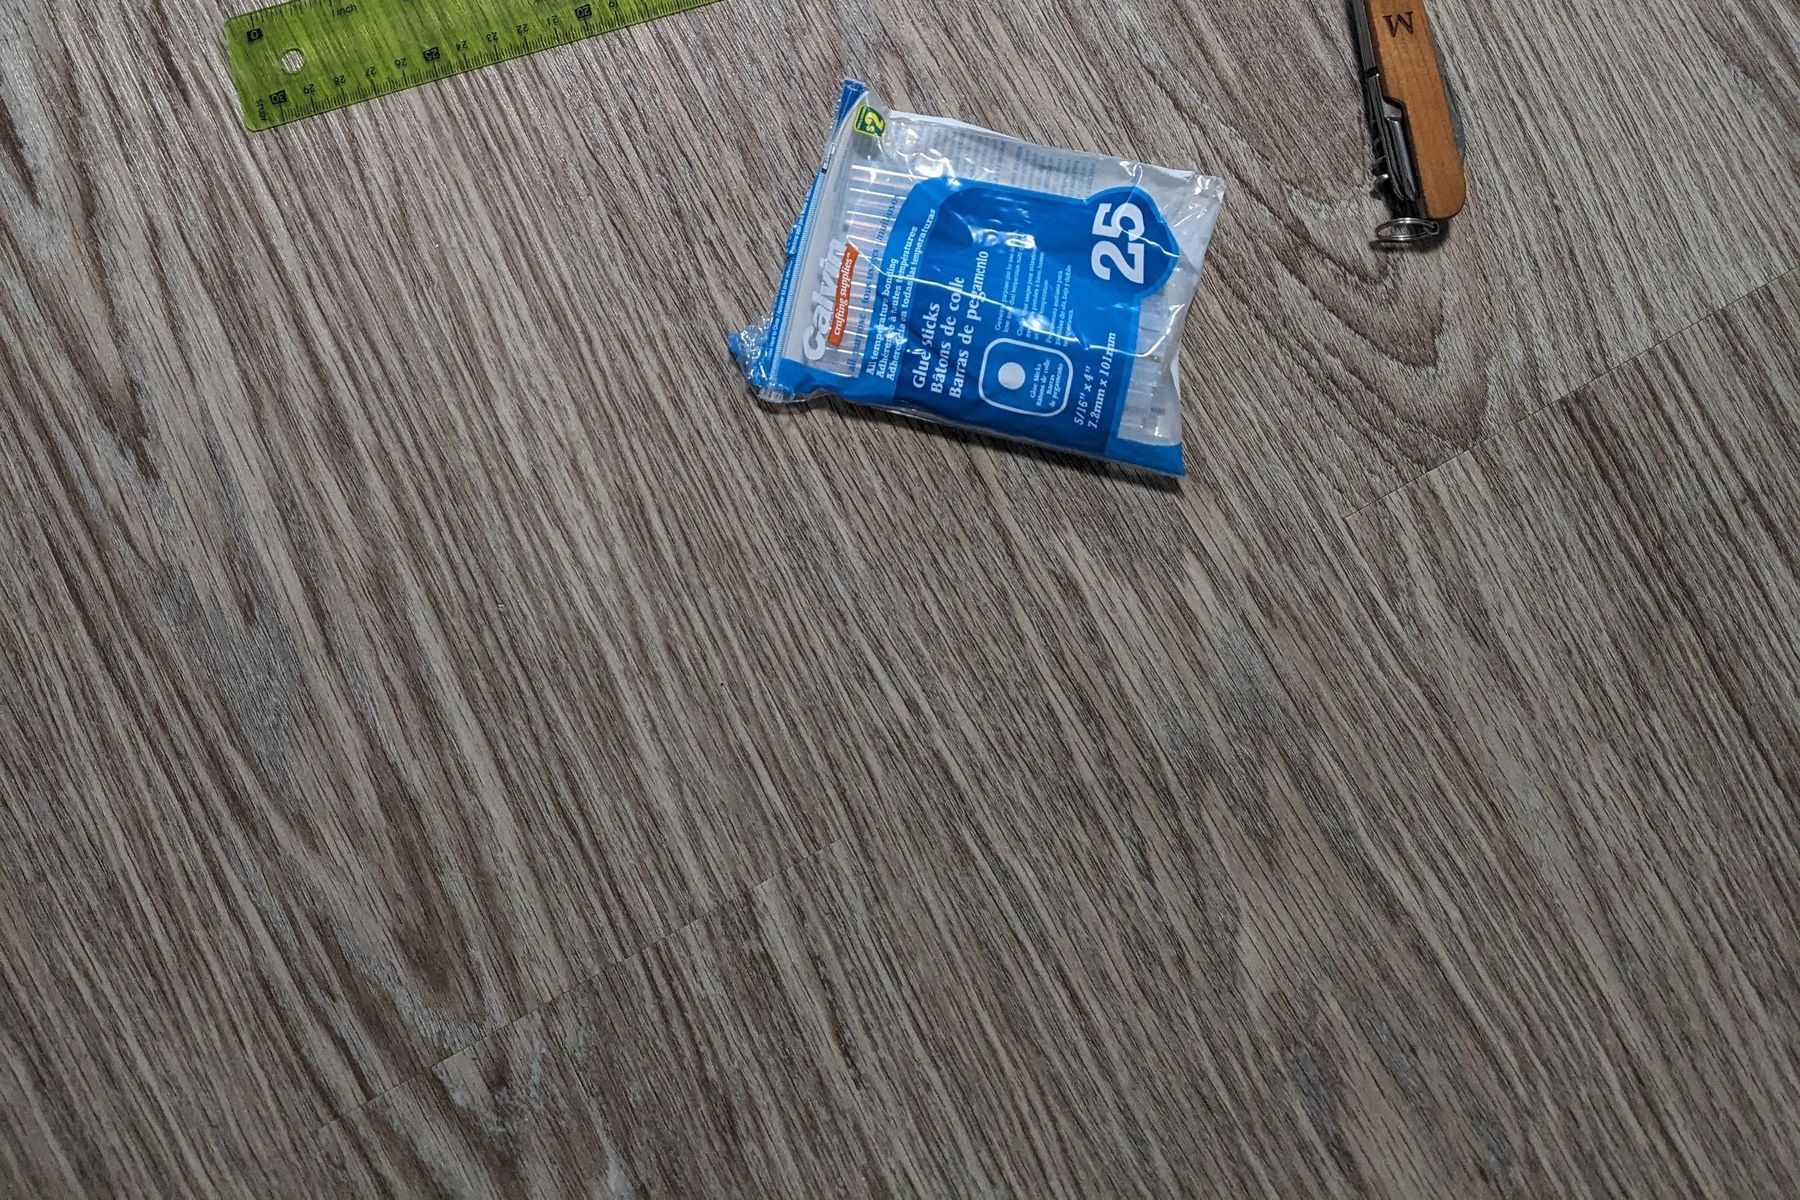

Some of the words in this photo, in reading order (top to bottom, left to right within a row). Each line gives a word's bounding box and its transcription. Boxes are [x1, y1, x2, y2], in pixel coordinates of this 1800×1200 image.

[574, 5, 591, 18] 20
[546, 14, 558, 25] 21
[250, 29, 259, 39] 0
[515, 23, 529, 33] 22
[485, 31, 498, 41] 23
[455, 40, 468, 50] 24
[423, 48, 439, 60] 25
[394, 57, 407, 68] 26
[363, 65, 376, 76] 27
[332, 74, 346, 85] 28
[302, 83, 315, 94] 29
[270, 90, 286, 104] 30
[1090, 200, 1146, 285] 25
[967, 251, 988, 320] pegamento
[802, 237, 849, 361] Calvin
[886, 323, 905, 380] Adherecia
[901, 279, 914, 308] todas
[911, 208, 935, 265] temperaturas
[833, 298, 850, 335] crafting
[866, 361, 876, 375] All
[871, 302, 888, 359] temperature
[881, 258, 898, 296] bonding
[939, 316, 956, 336] de
[957, 325, 974, 344] de
[1099, 332, 1116, 376] 101mm
[912, 348, 931, 388] Glue
[930, 341, 951, 393] Bâtons
[949, 349, 969, 398] Barras
[1083, 383, 1092, 392] x
[1099, 378, 1107, 387] x
[1087, 388, 1105, 428] 7.2mm
